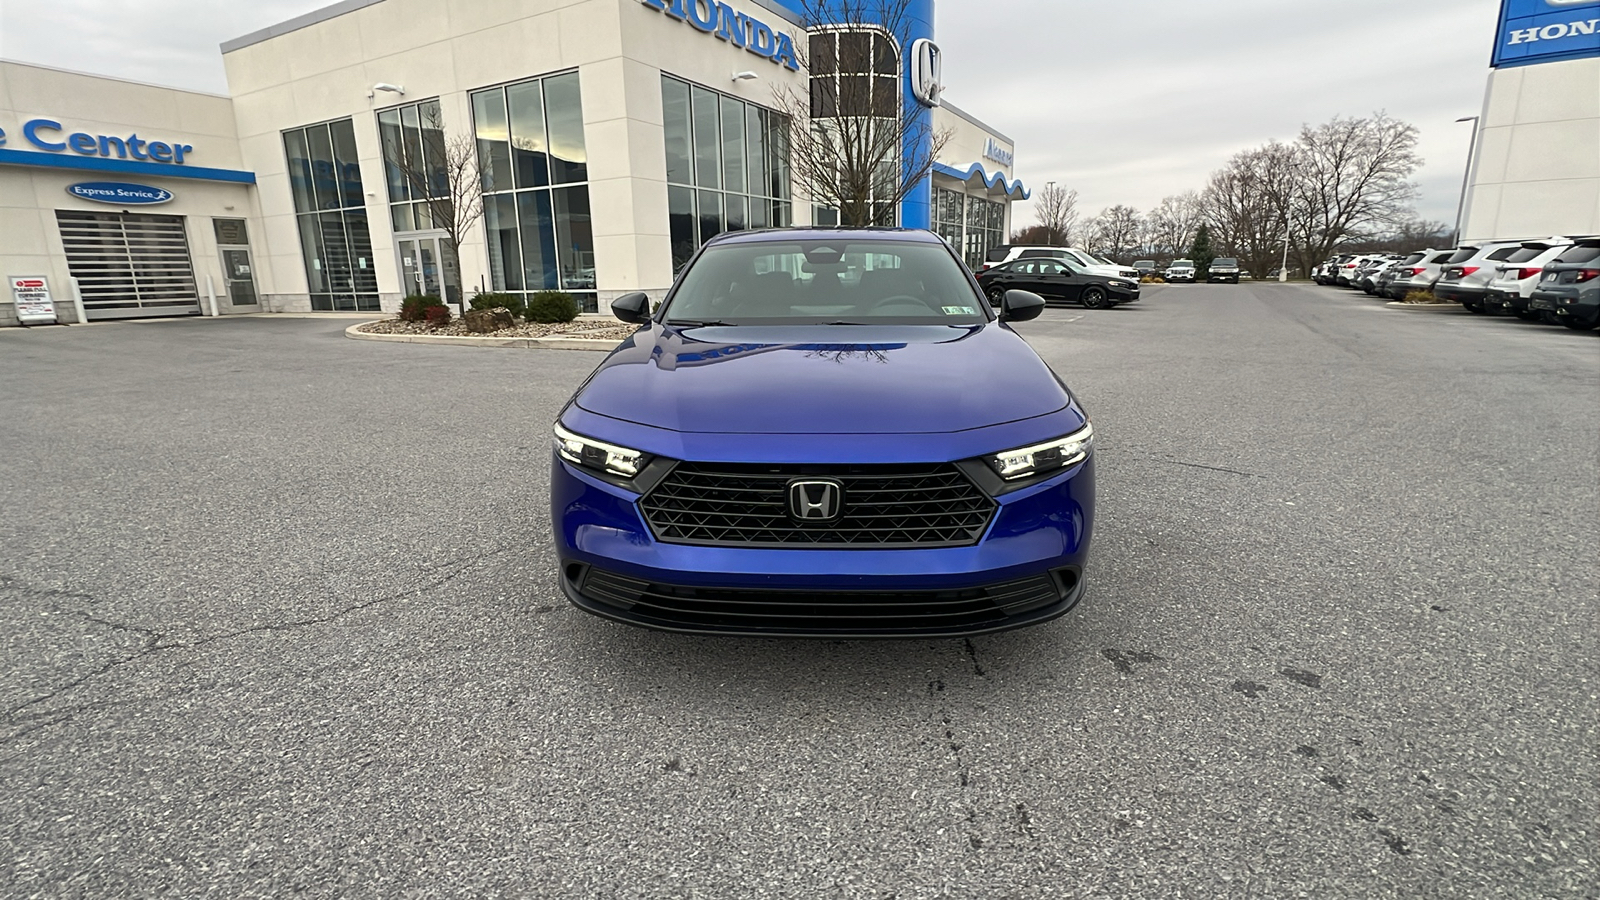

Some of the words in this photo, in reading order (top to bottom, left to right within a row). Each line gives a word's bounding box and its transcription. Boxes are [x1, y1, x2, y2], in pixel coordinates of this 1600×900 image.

[1507, 19, 1600, 45] HON
[23, 118, 193, 165] Center
[74, 186, 115, 196] Express
[117, 189, 154, 199] Service
